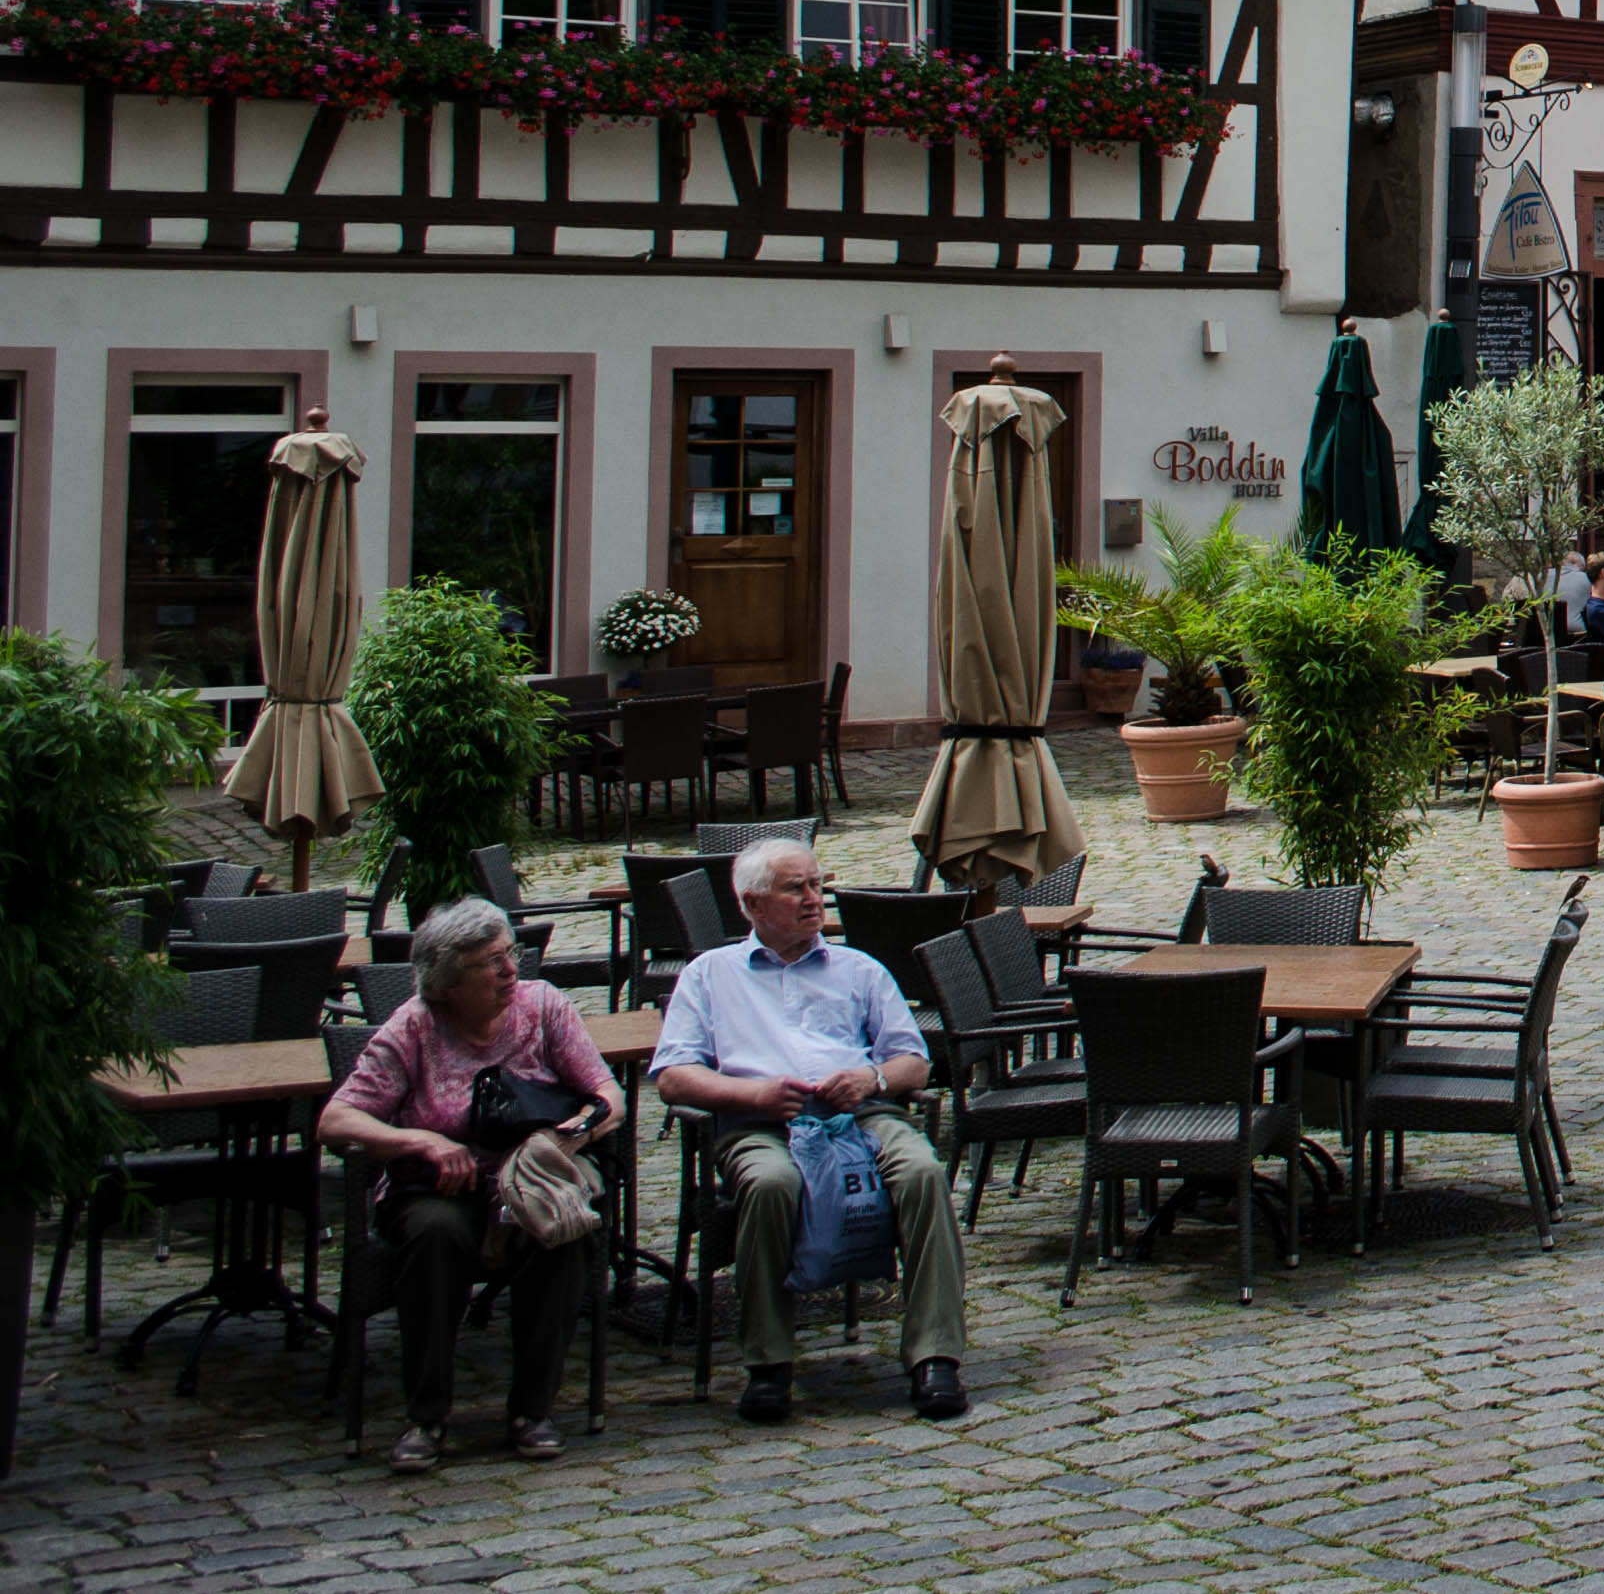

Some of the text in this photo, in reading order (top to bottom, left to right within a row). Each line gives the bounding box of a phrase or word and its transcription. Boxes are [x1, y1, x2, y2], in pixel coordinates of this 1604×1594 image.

[1534, 234, 1555, 247] Bistro
[1187, 425, 1229, 442] Villa
[1153, 440, 1286, 483] Boddin
[1233, 483, 1284, 498] HOTEL
[845, 1170, 886, 1195] BI
